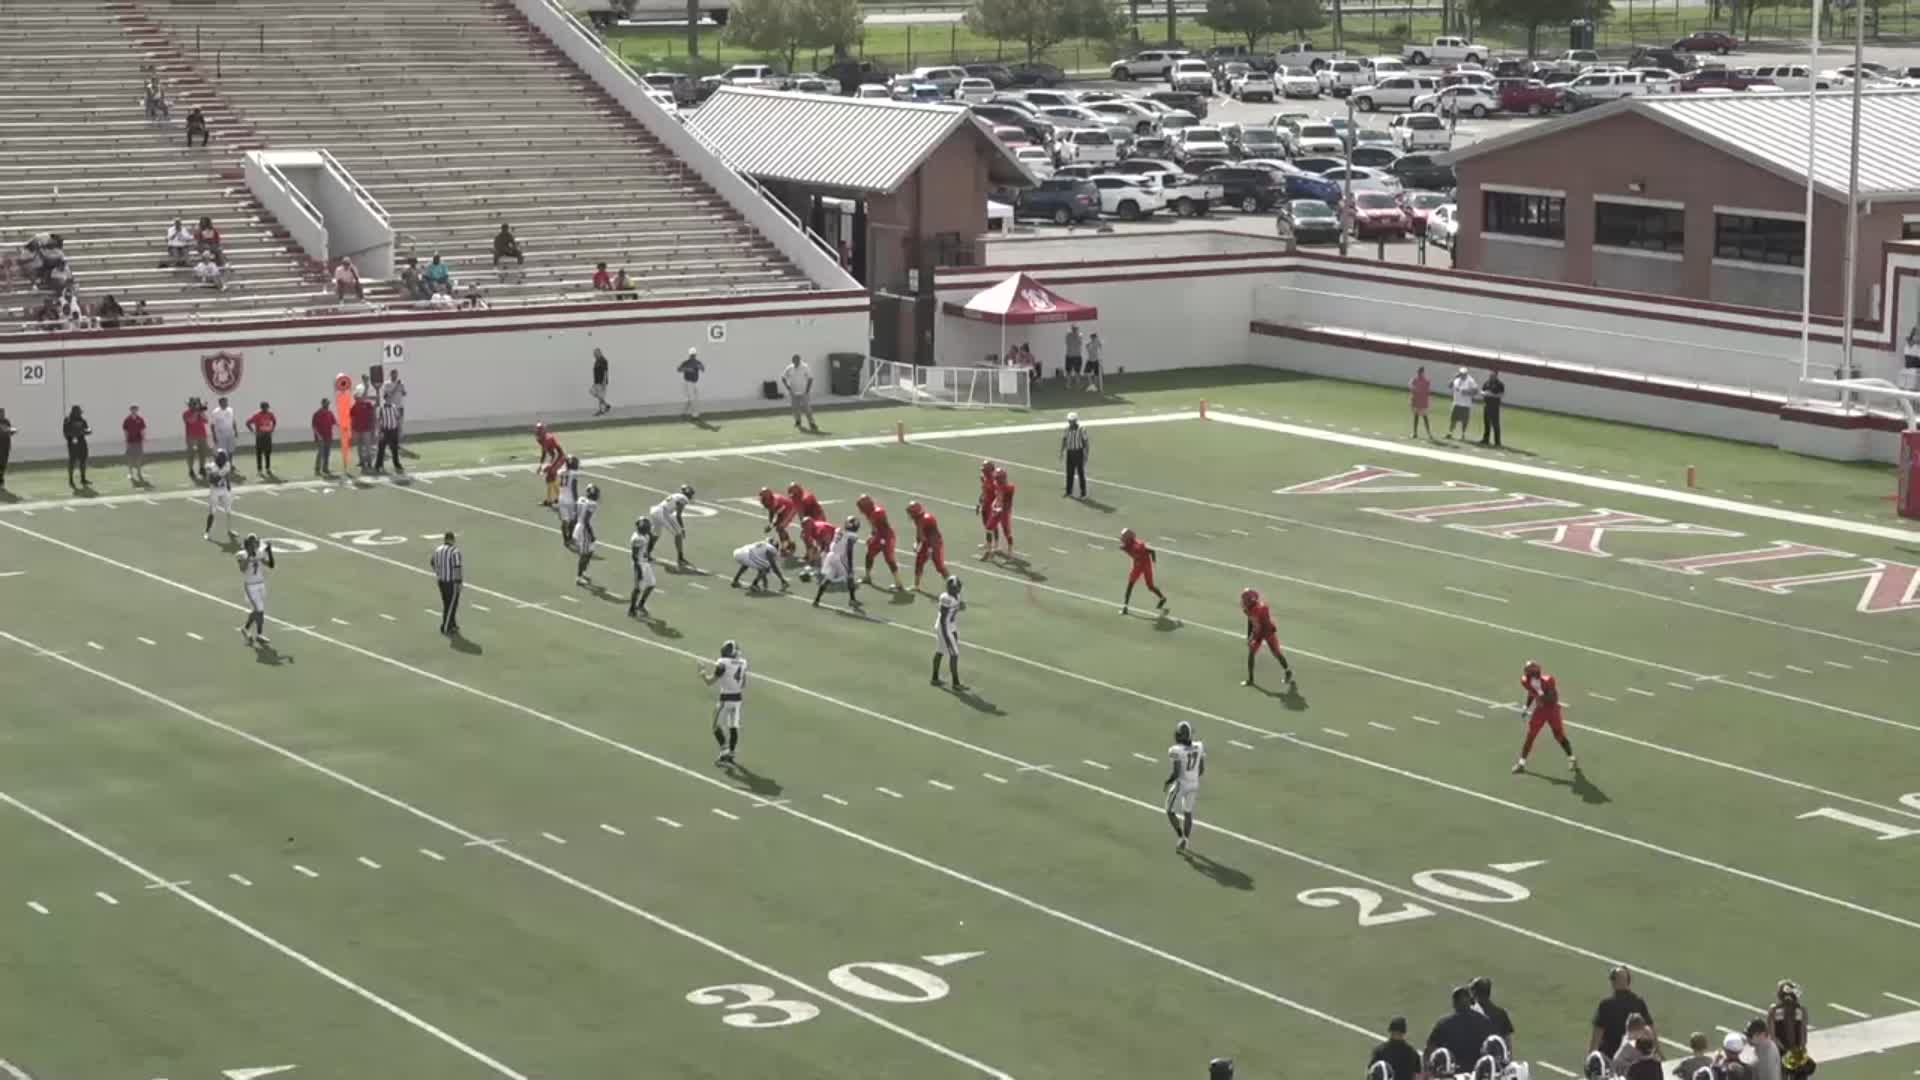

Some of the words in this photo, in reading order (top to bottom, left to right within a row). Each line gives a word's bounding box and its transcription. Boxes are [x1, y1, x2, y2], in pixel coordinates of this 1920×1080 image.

[710, 325, 724, 339] G
[384, 344, 403, 358] 10
[23, 366, 43, 380] 20
[1273, 464, 1920, 613] VIKIN
[1186, 751, 1199, 771] 17
[1297, 868, 1531, 927] 20
[685, 961, 950, 1028] 30
